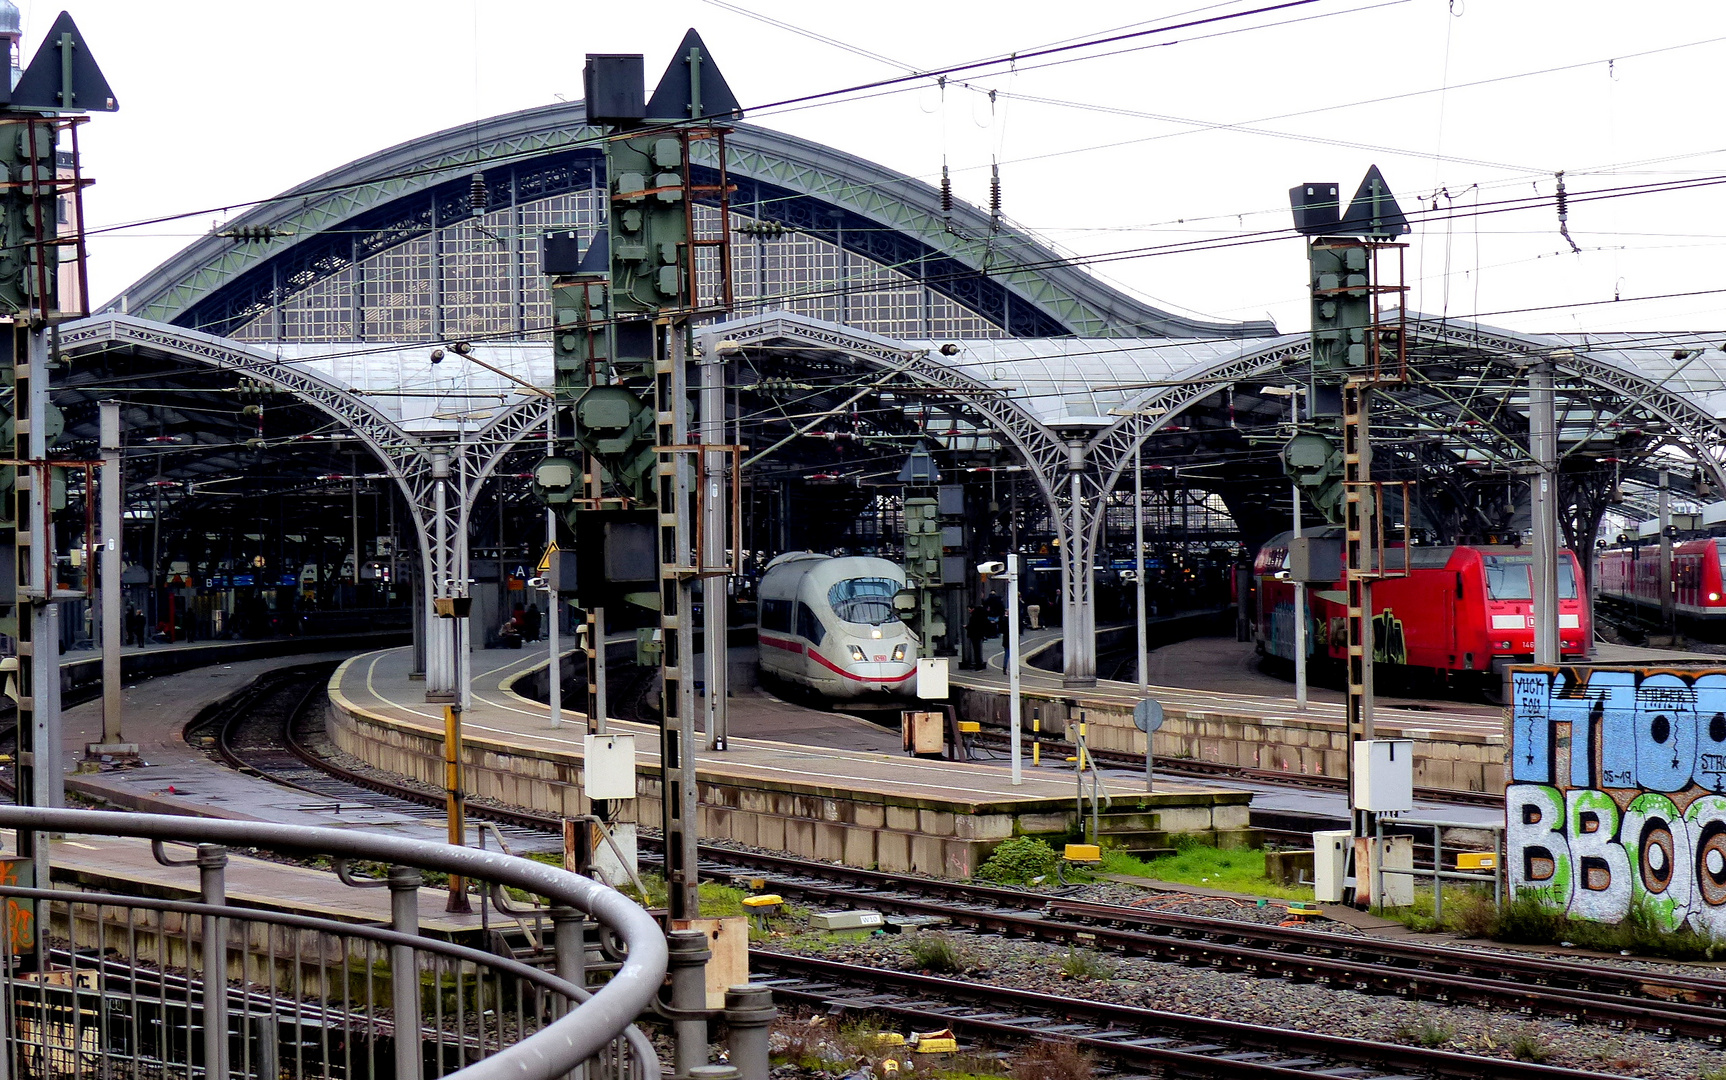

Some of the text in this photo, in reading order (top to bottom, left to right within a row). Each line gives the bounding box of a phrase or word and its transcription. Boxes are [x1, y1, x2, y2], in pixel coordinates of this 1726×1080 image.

[515, 565, 526, 577] A
[206, 579, 213, 588] B
[1515, 677, 1545, 696] YUCK
